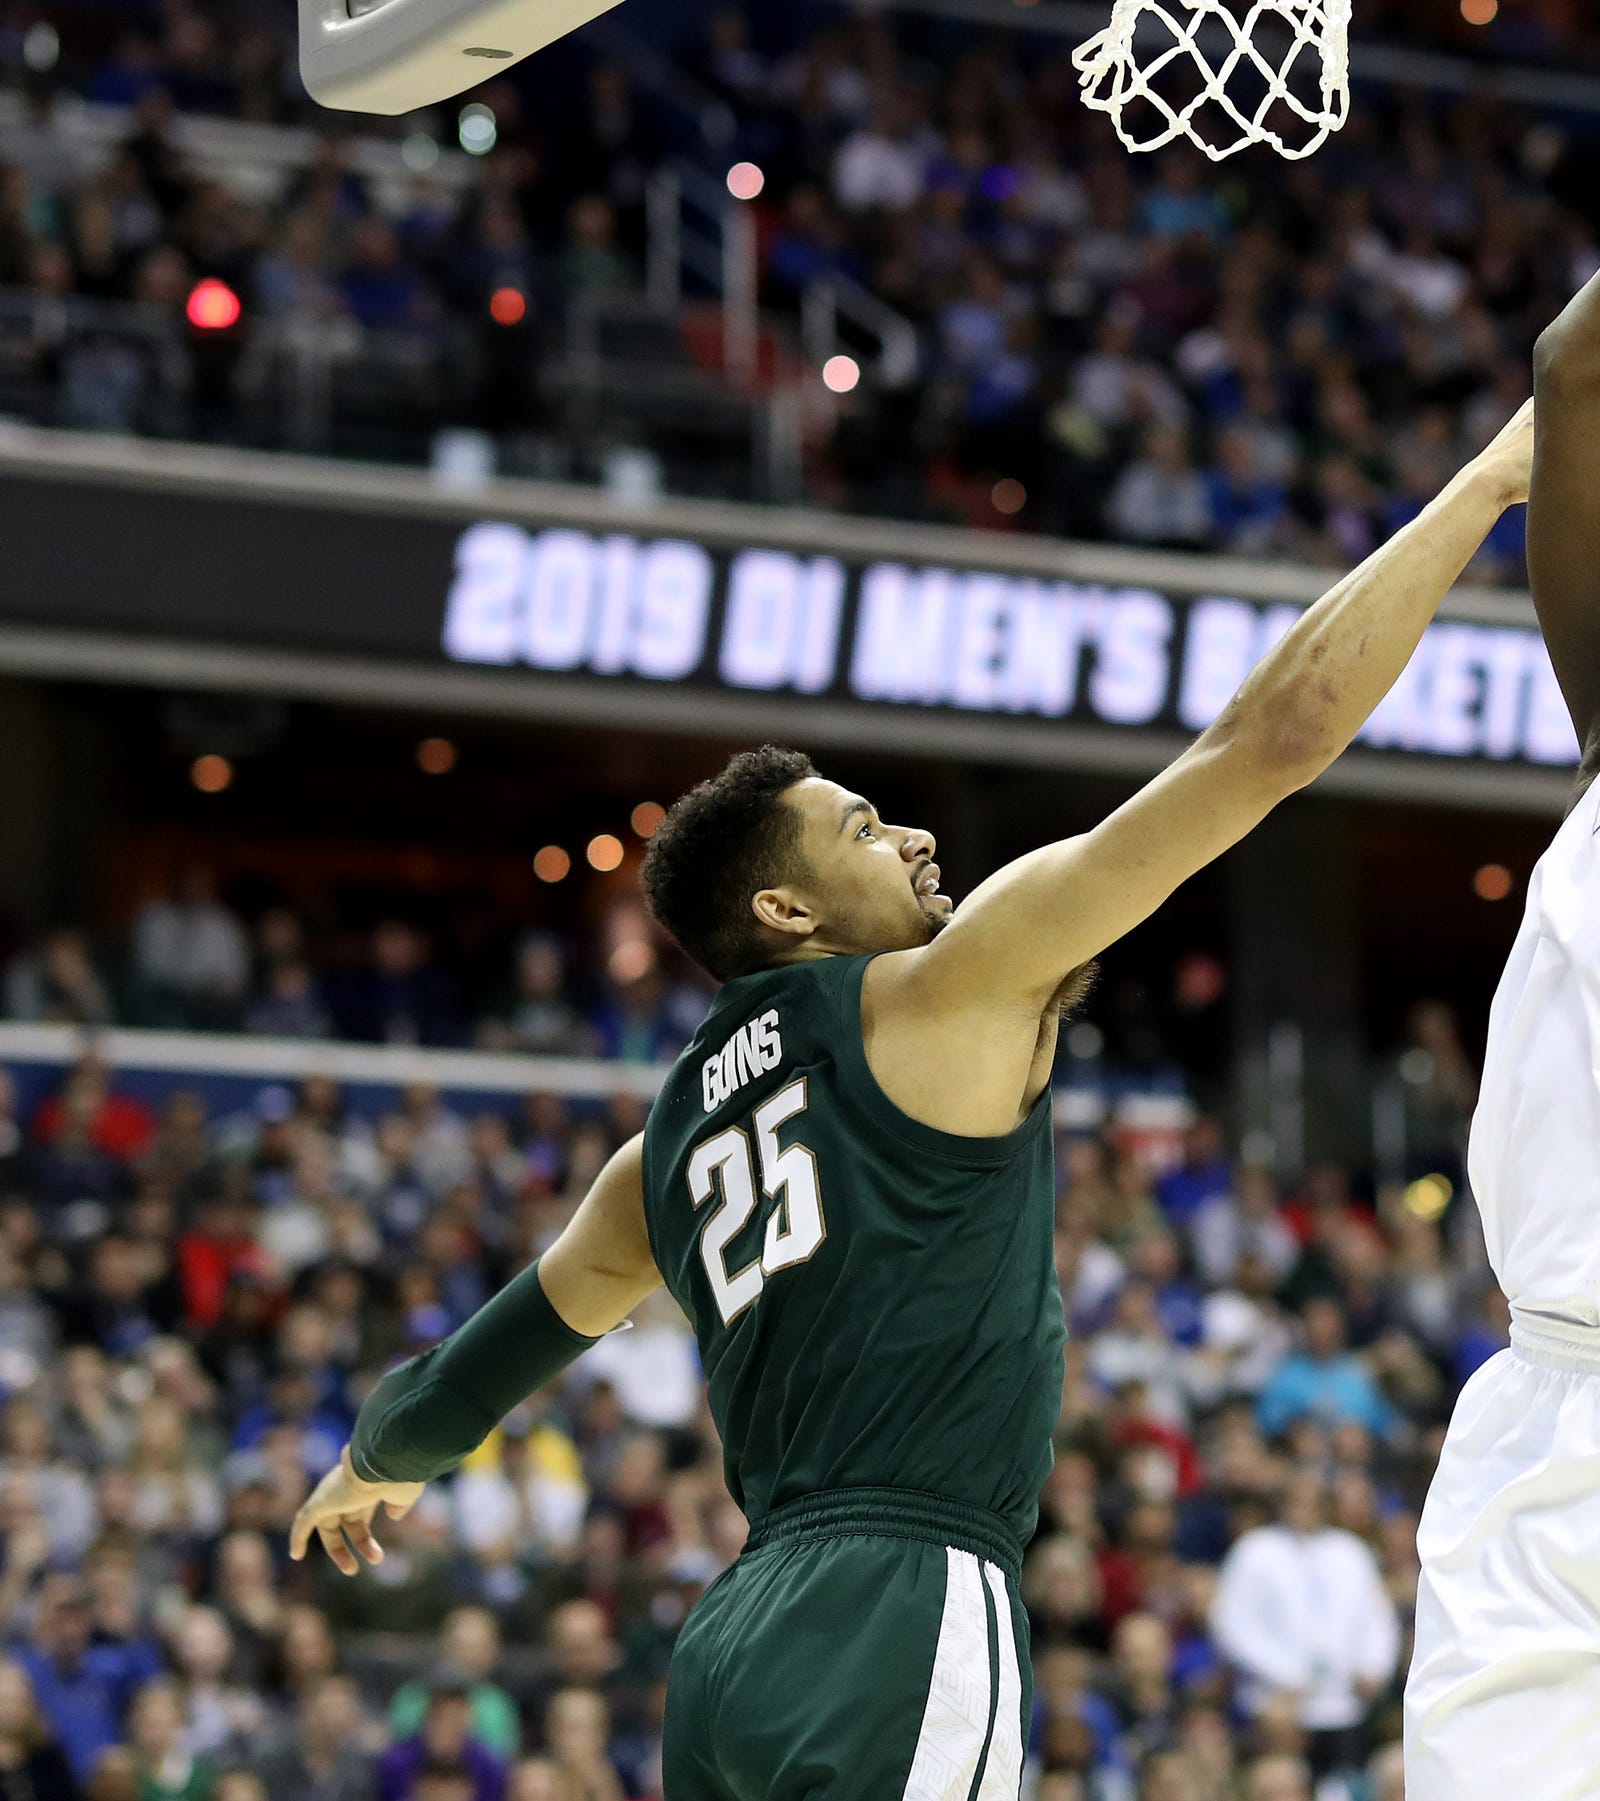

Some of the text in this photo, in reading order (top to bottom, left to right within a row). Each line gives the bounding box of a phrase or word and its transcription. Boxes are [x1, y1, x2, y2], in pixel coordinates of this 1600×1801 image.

[441, 521, 713, 682] 2019
[850, 561, 1175, 727] MEN'S
[702, 1008, 782, 1114] GOINS
[685, 1076, 828, 1329] 25
